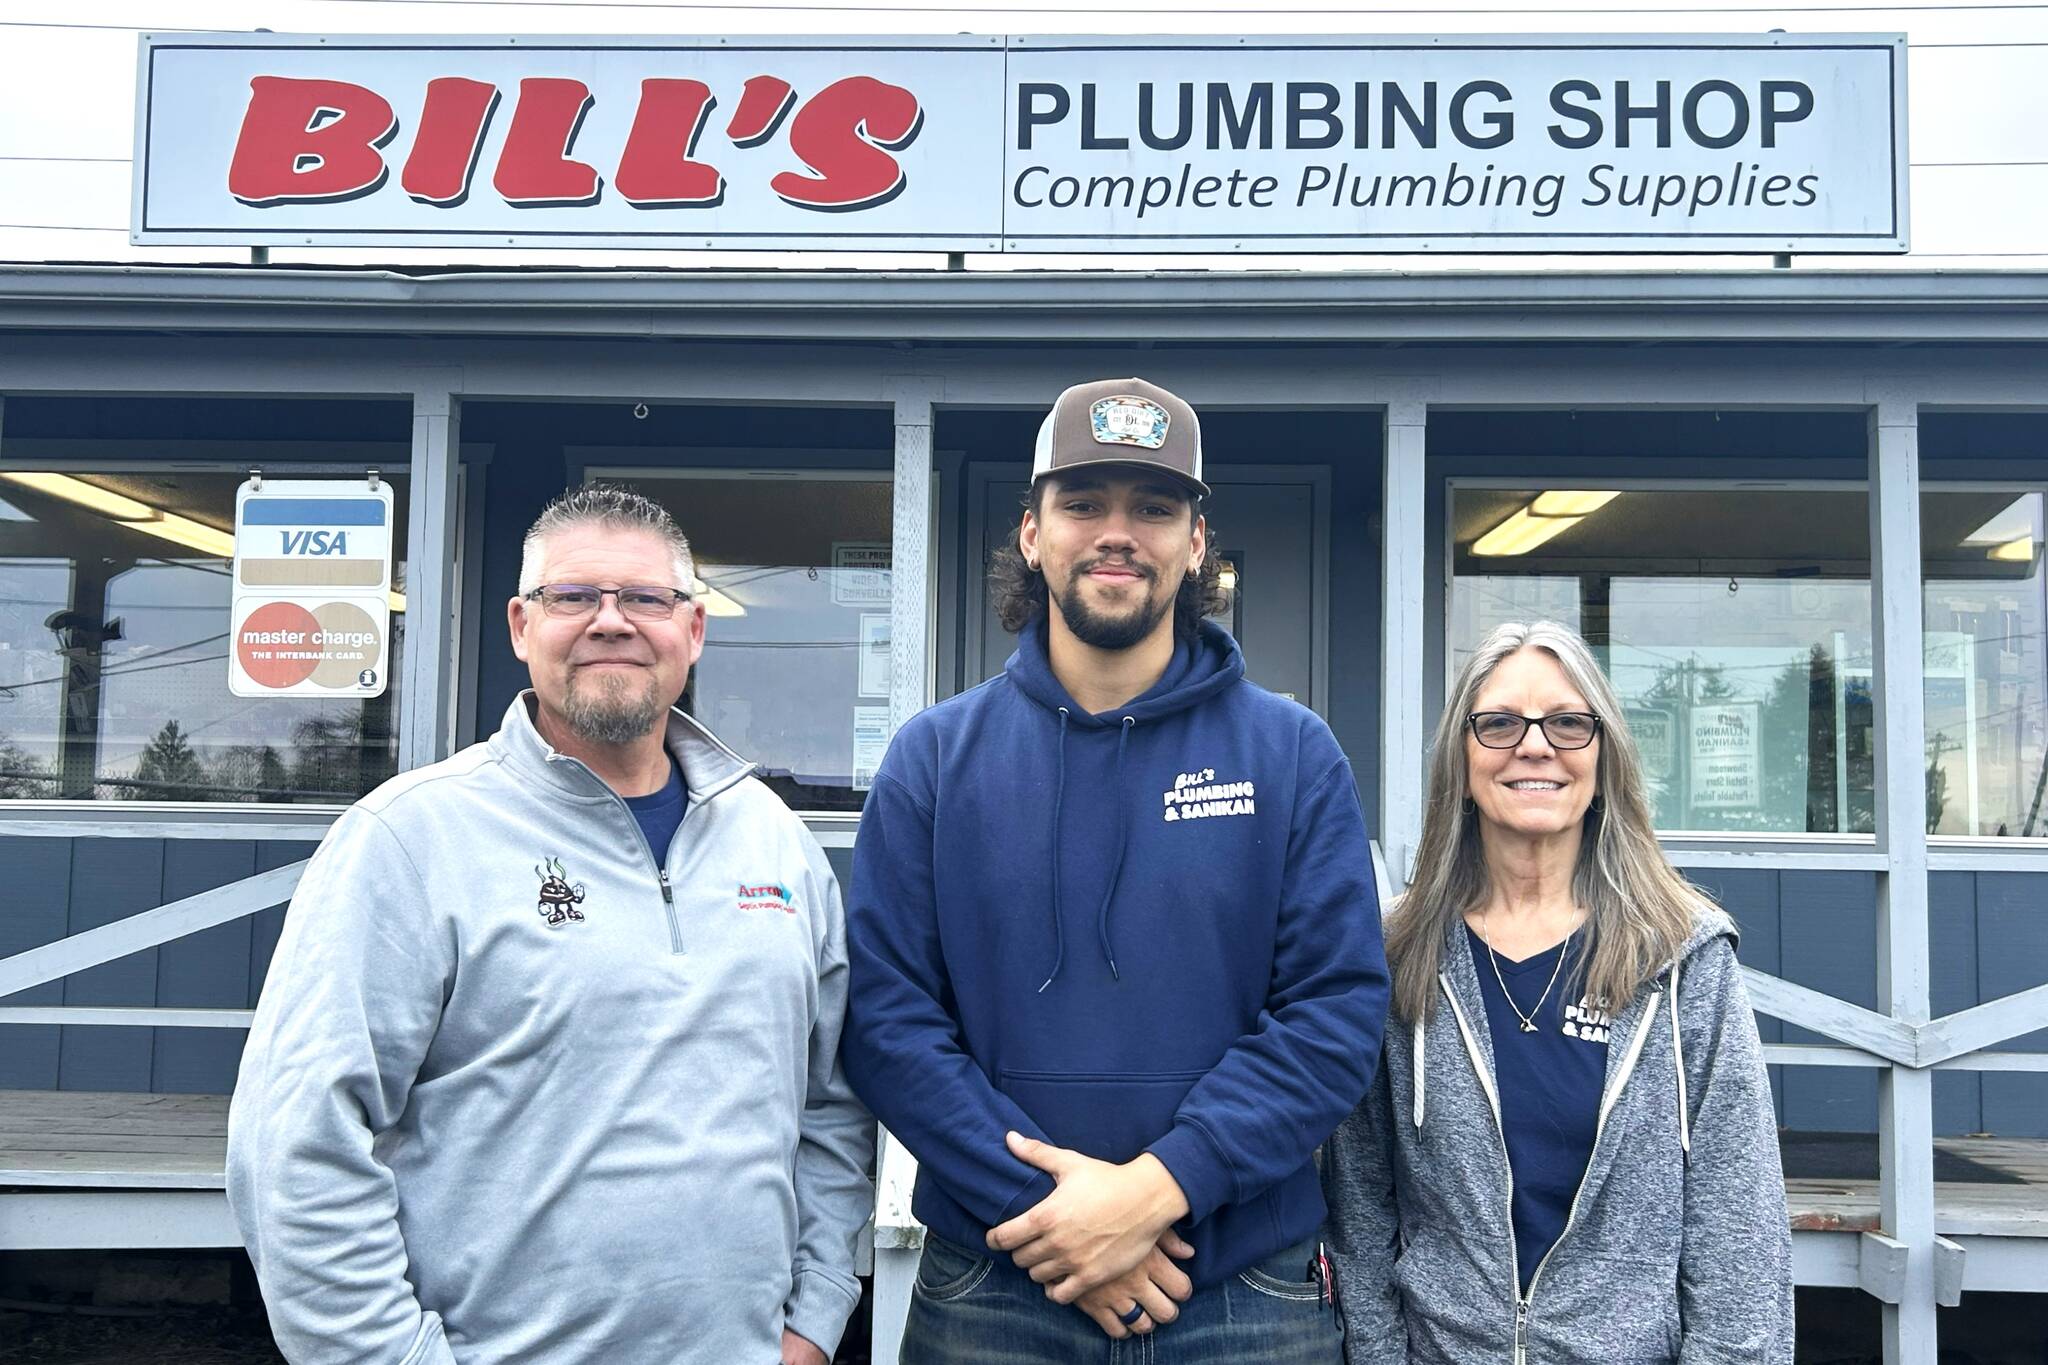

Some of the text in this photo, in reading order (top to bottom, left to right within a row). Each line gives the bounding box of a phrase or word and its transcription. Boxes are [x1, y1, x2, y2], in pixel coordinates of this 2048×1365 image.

[1017, 79, 1815, 150] PLUMBING SHOP
[229, 75, 924, 209] BILL'S
[1013, 162, 1819, 218] Complete Plumbing Supplies
[280, 530, 347, 555] VISA
[243, 629, 378, 649] master charge.
[252, 651, 272, 660] THE
[276, 651, 332, 660] INTERBANK
[1163, 781, 1255, 806] PLUMBING
[1164, 798, 1255, 821] & SANIKAN
[1562, 1021, 1579, 1037] &
